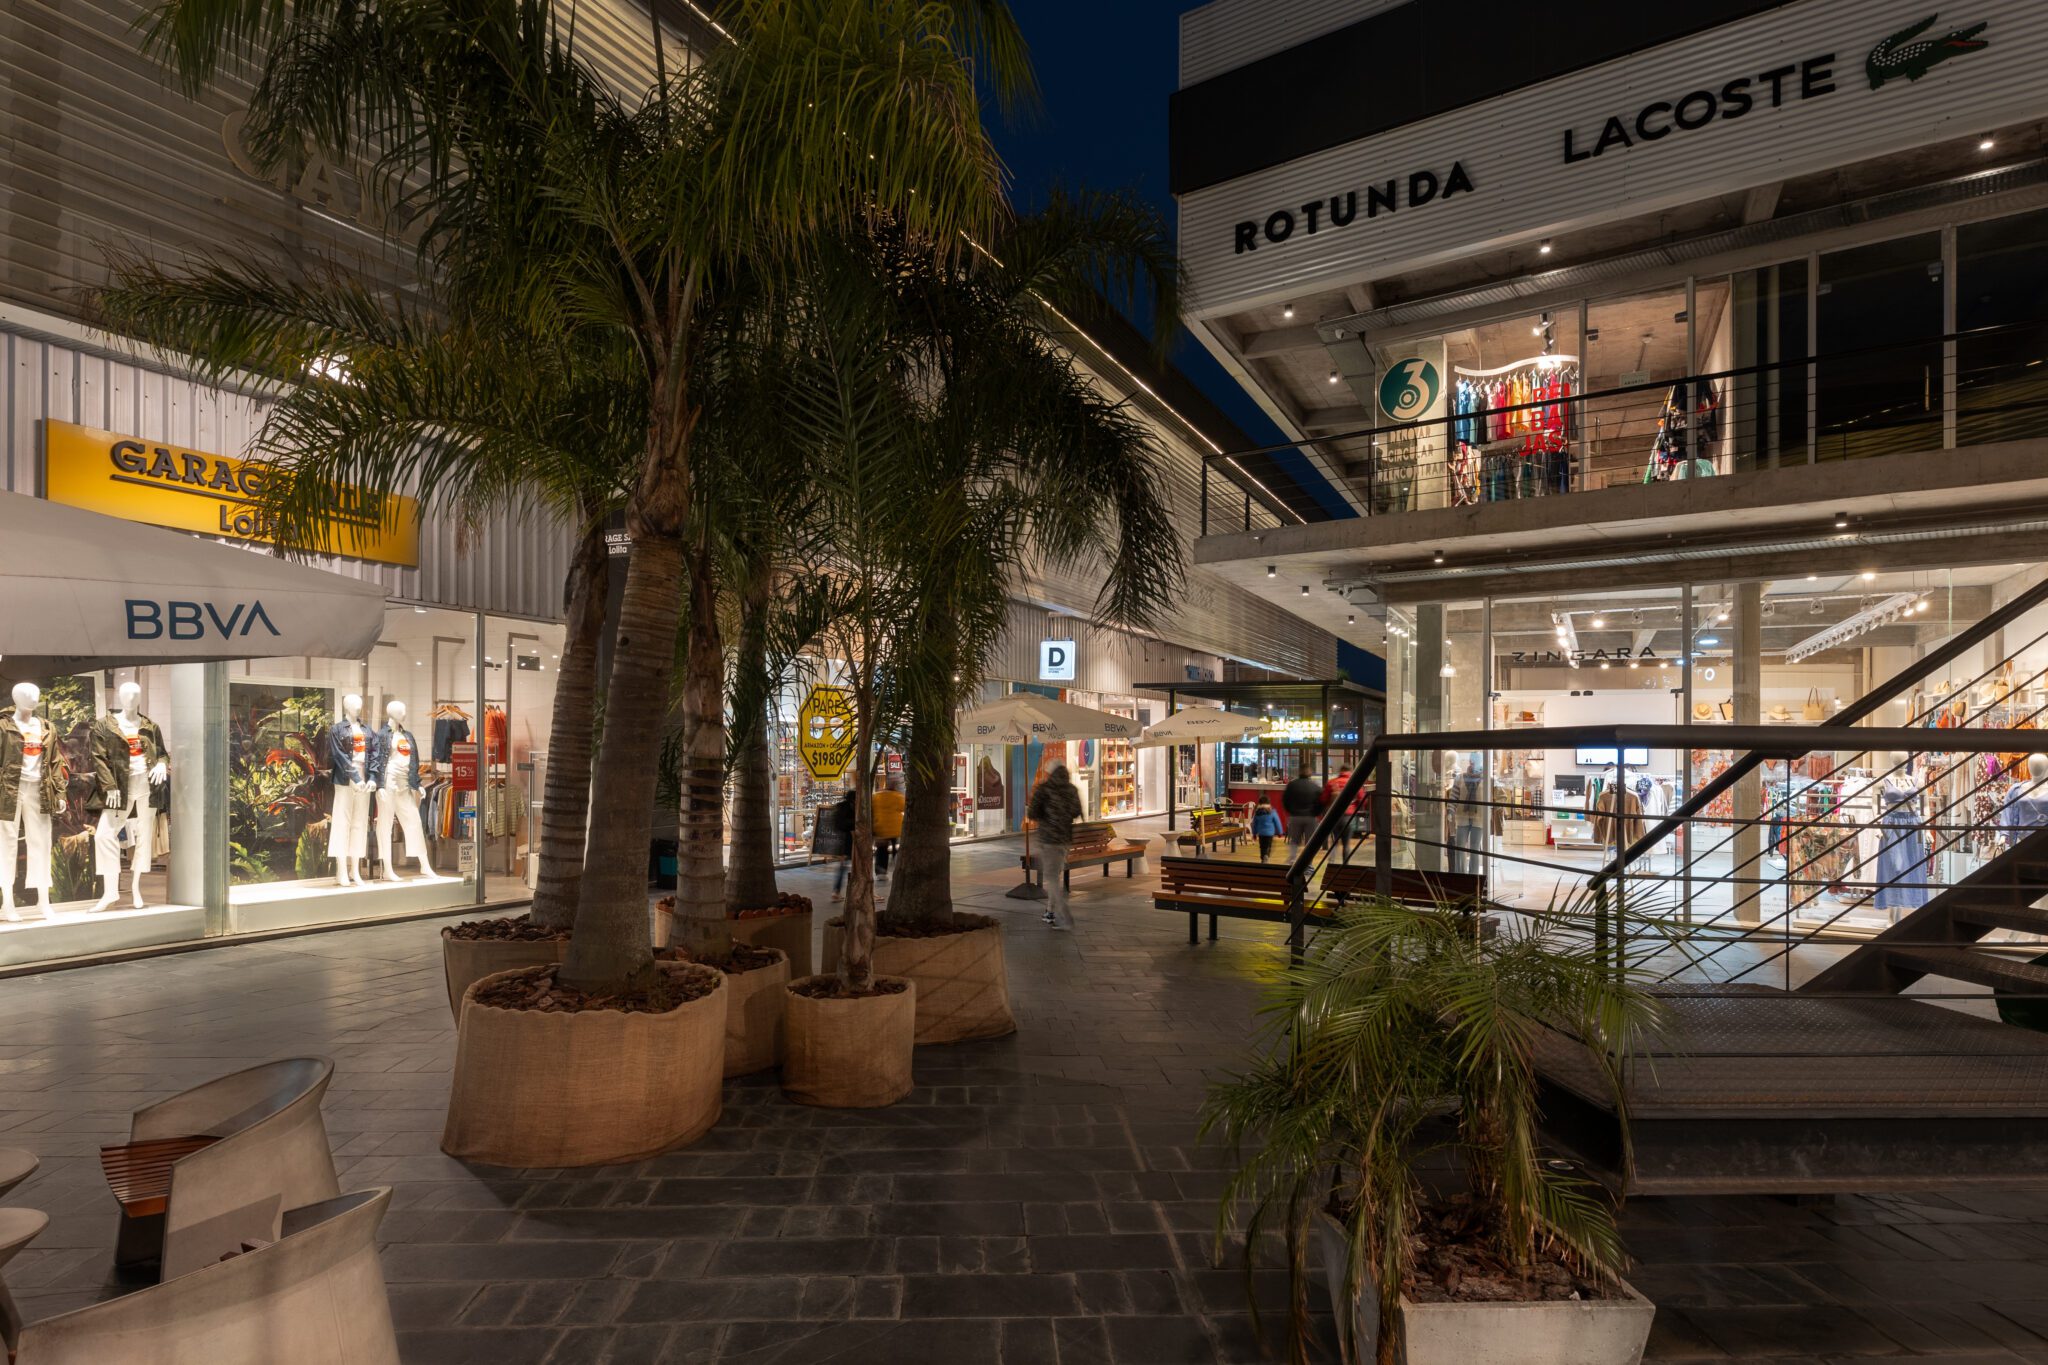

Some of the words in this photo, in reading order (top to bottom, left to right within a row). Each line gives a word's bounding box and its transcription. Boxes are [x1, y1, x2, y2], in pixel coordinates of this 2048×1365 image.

[1563, 53, 1836, 164] LACOSTE
[1234, 160, 1474, 255] ROTUNDA
[608, 545, 628, 555] Lolita
[125, 599, 282, 641] BBVA
[1048, 647, 1065, 667] D
[1511, 646, 1657, 662] ZINGARA
[813, 698, 841, 715] PARE
[1032, 722, 1058, 732] BBVA
[1104, 723, 1128, 733] BBVA
[811, 750, 843, 768] $1980
[890, 761, 901, 769] SALE
[455, 766, 475, 778] 15%
